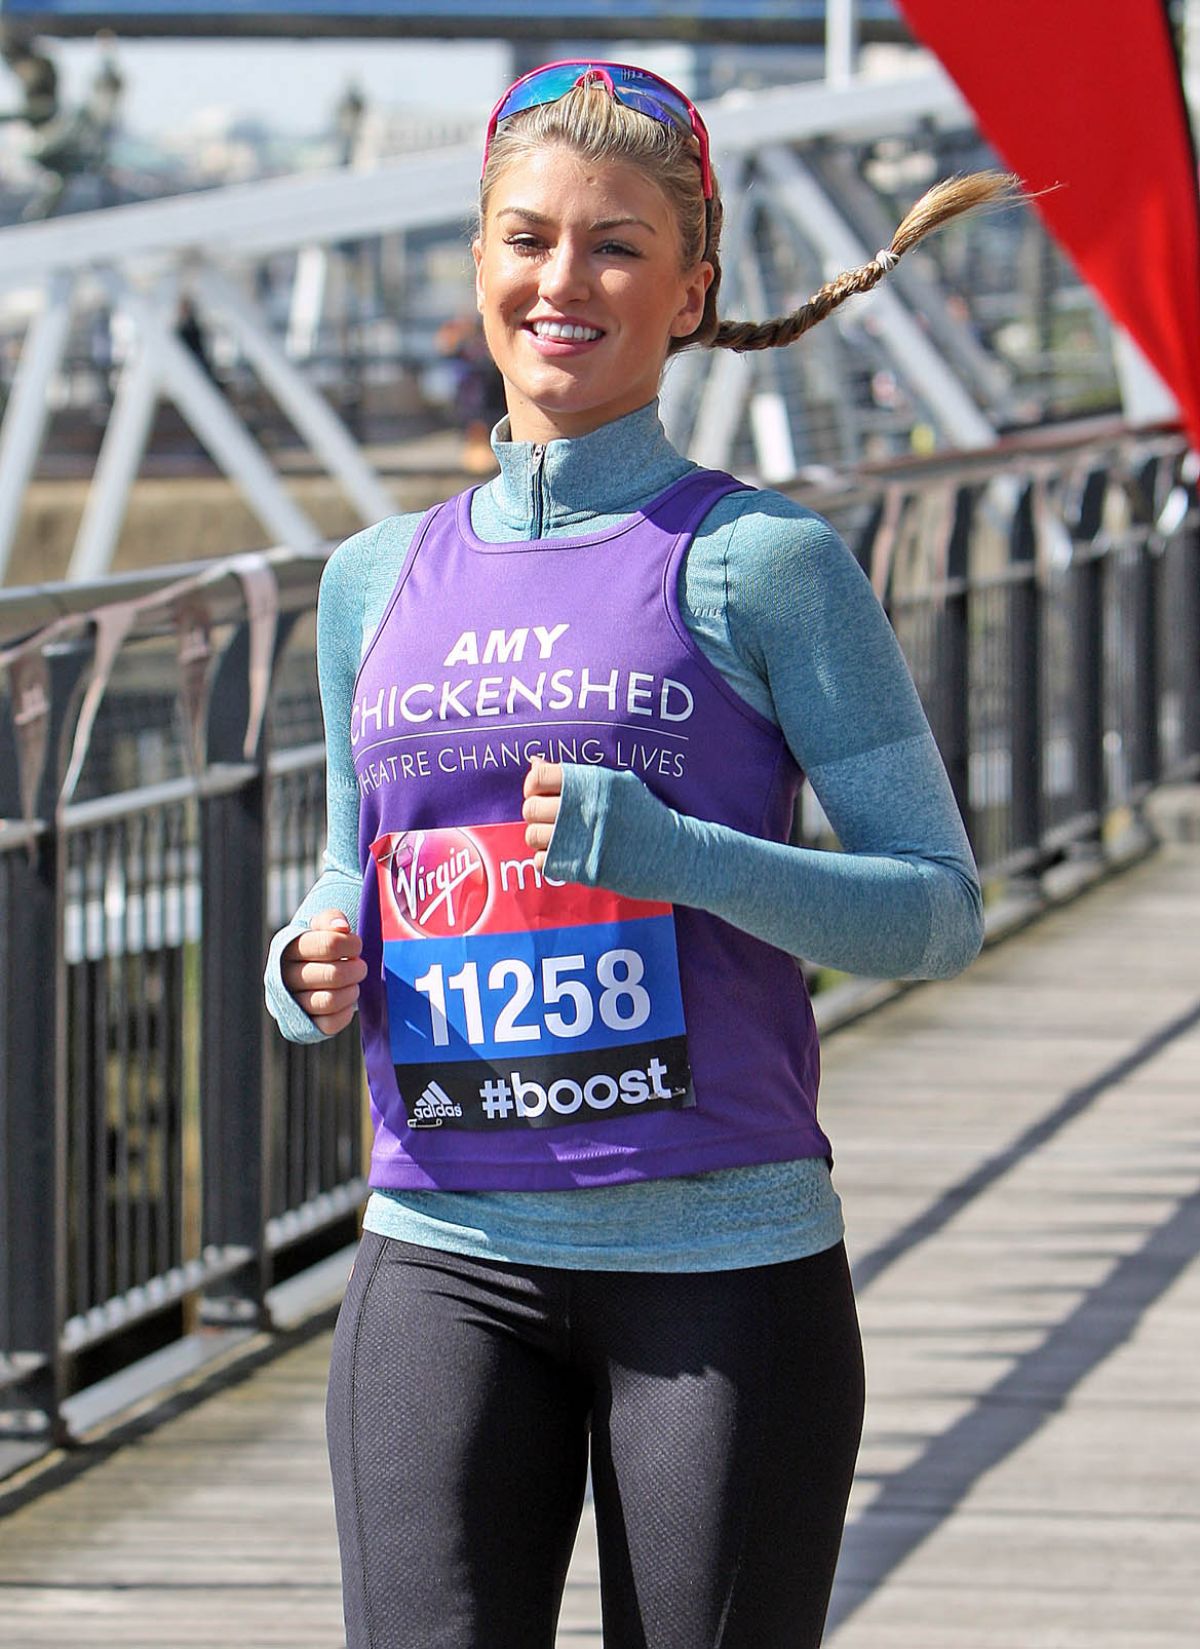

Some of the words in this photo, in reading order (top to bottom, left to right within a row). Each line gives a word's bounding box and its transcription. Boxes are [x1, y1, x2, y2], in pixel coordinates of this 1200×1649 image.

[443, 623, 570, 667] AMY
[351, 668, 696, 746] CHICKENSHED
[438, 738, 605, 774] CHANGING
[616, 741, 686, 779] LIVES
[395, 832, 480, 928] Virgin
[414, 948, 652, 1048] 11258
[413, 1102, 462, 1119] adidas
[479, 1057, 672, 1119] #boost
